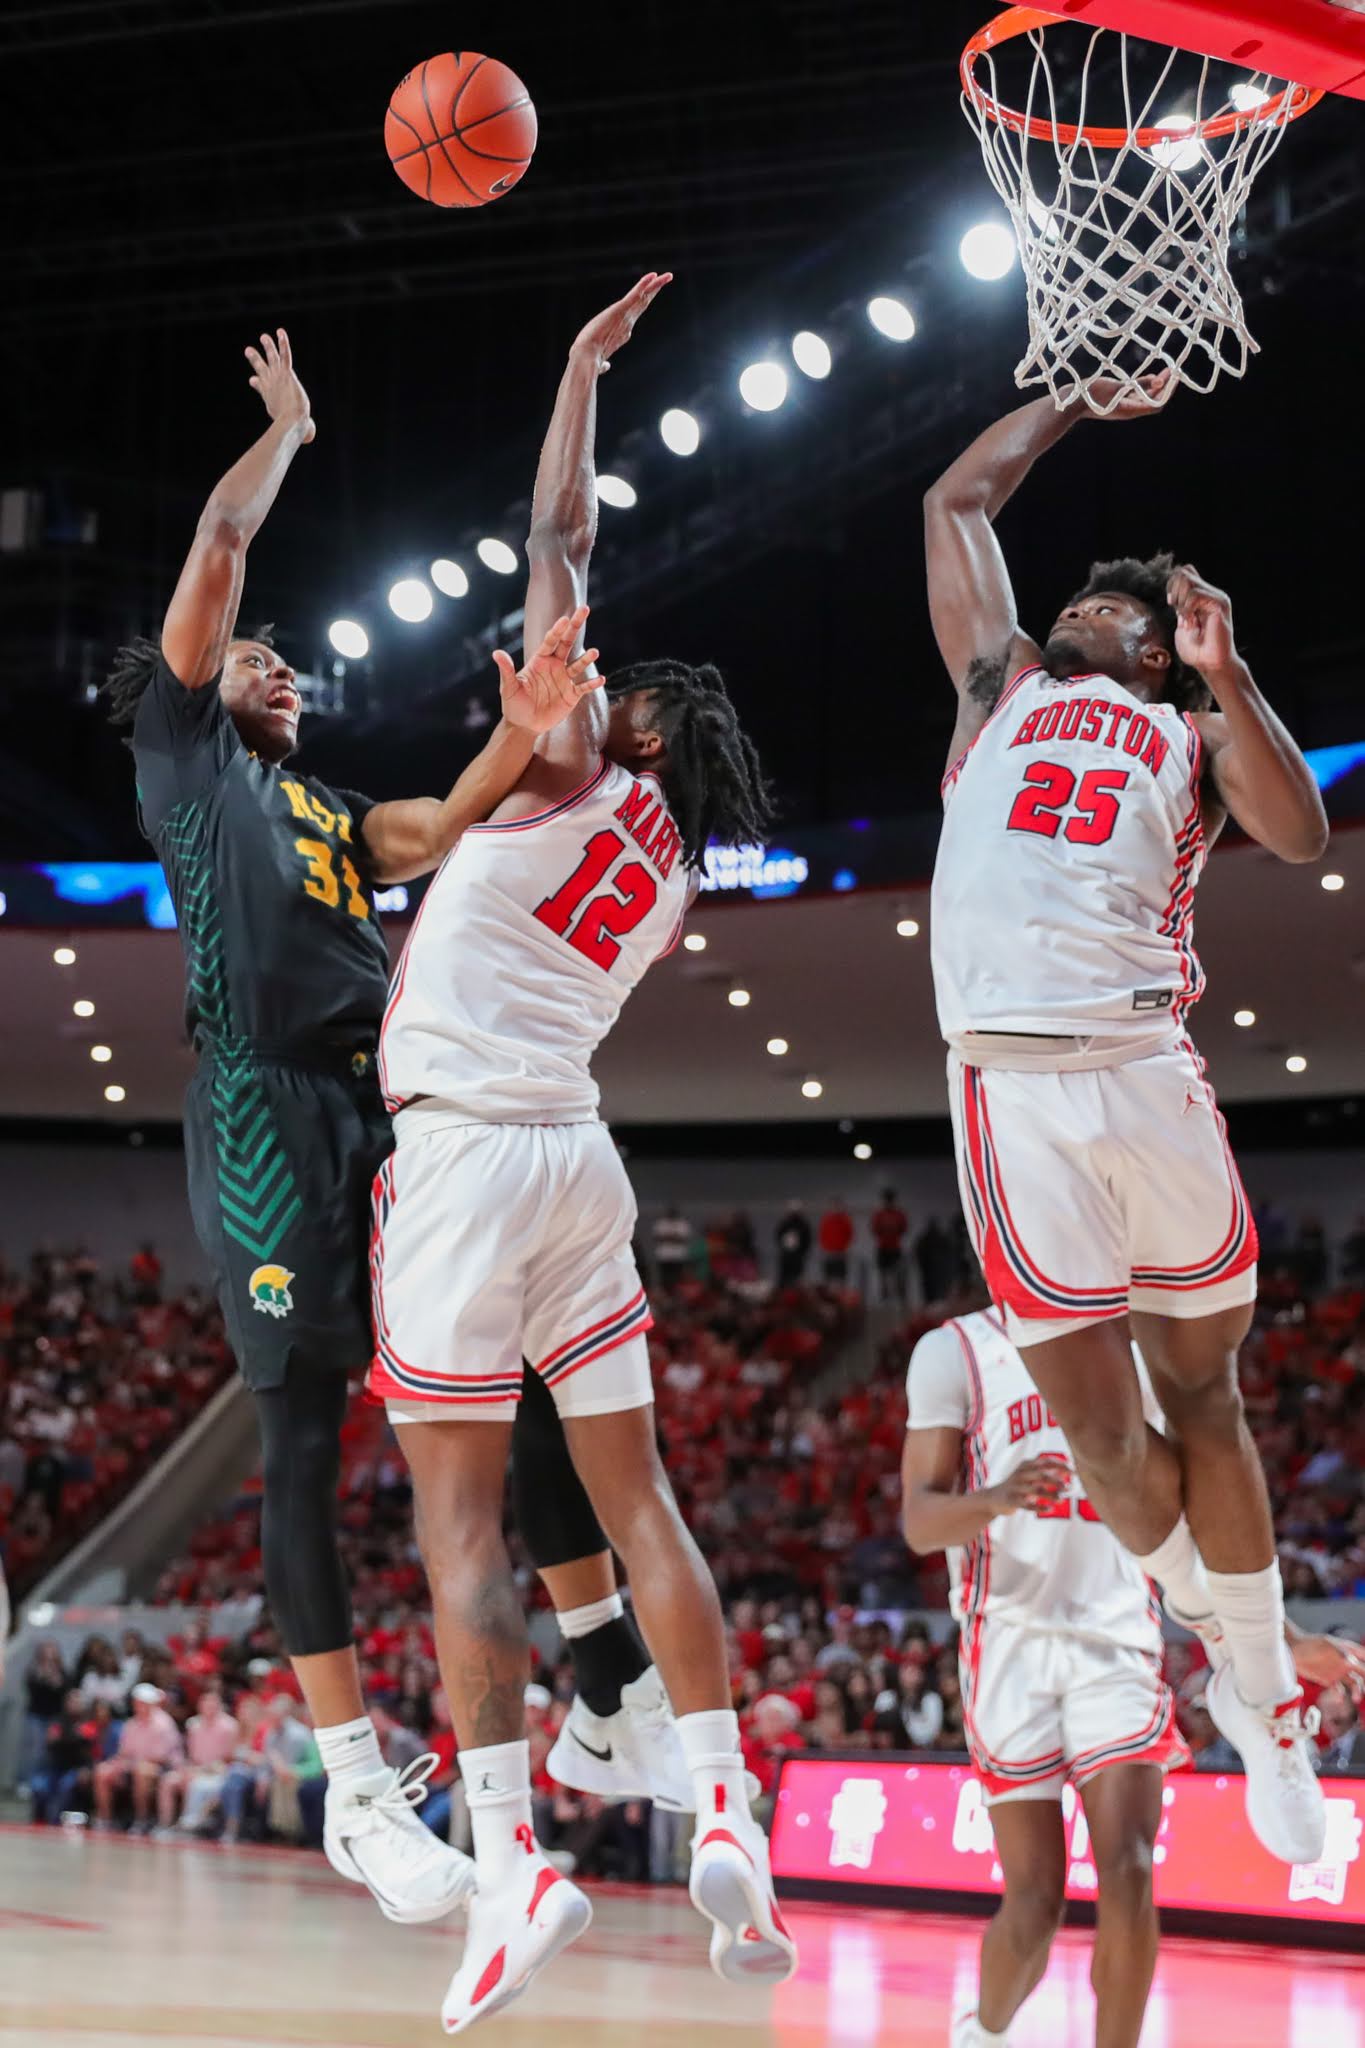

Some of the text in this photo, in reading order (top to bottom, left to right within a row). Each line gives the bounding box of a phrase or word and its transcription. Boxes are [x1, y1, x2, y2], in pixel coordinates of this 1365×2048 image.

[1008, 698, 1169, 778] HOUSTON
[1007, 760, 1130, 846] 25
[294, 837, 369, 920] 31
[532, 828, 657, 972] 12
